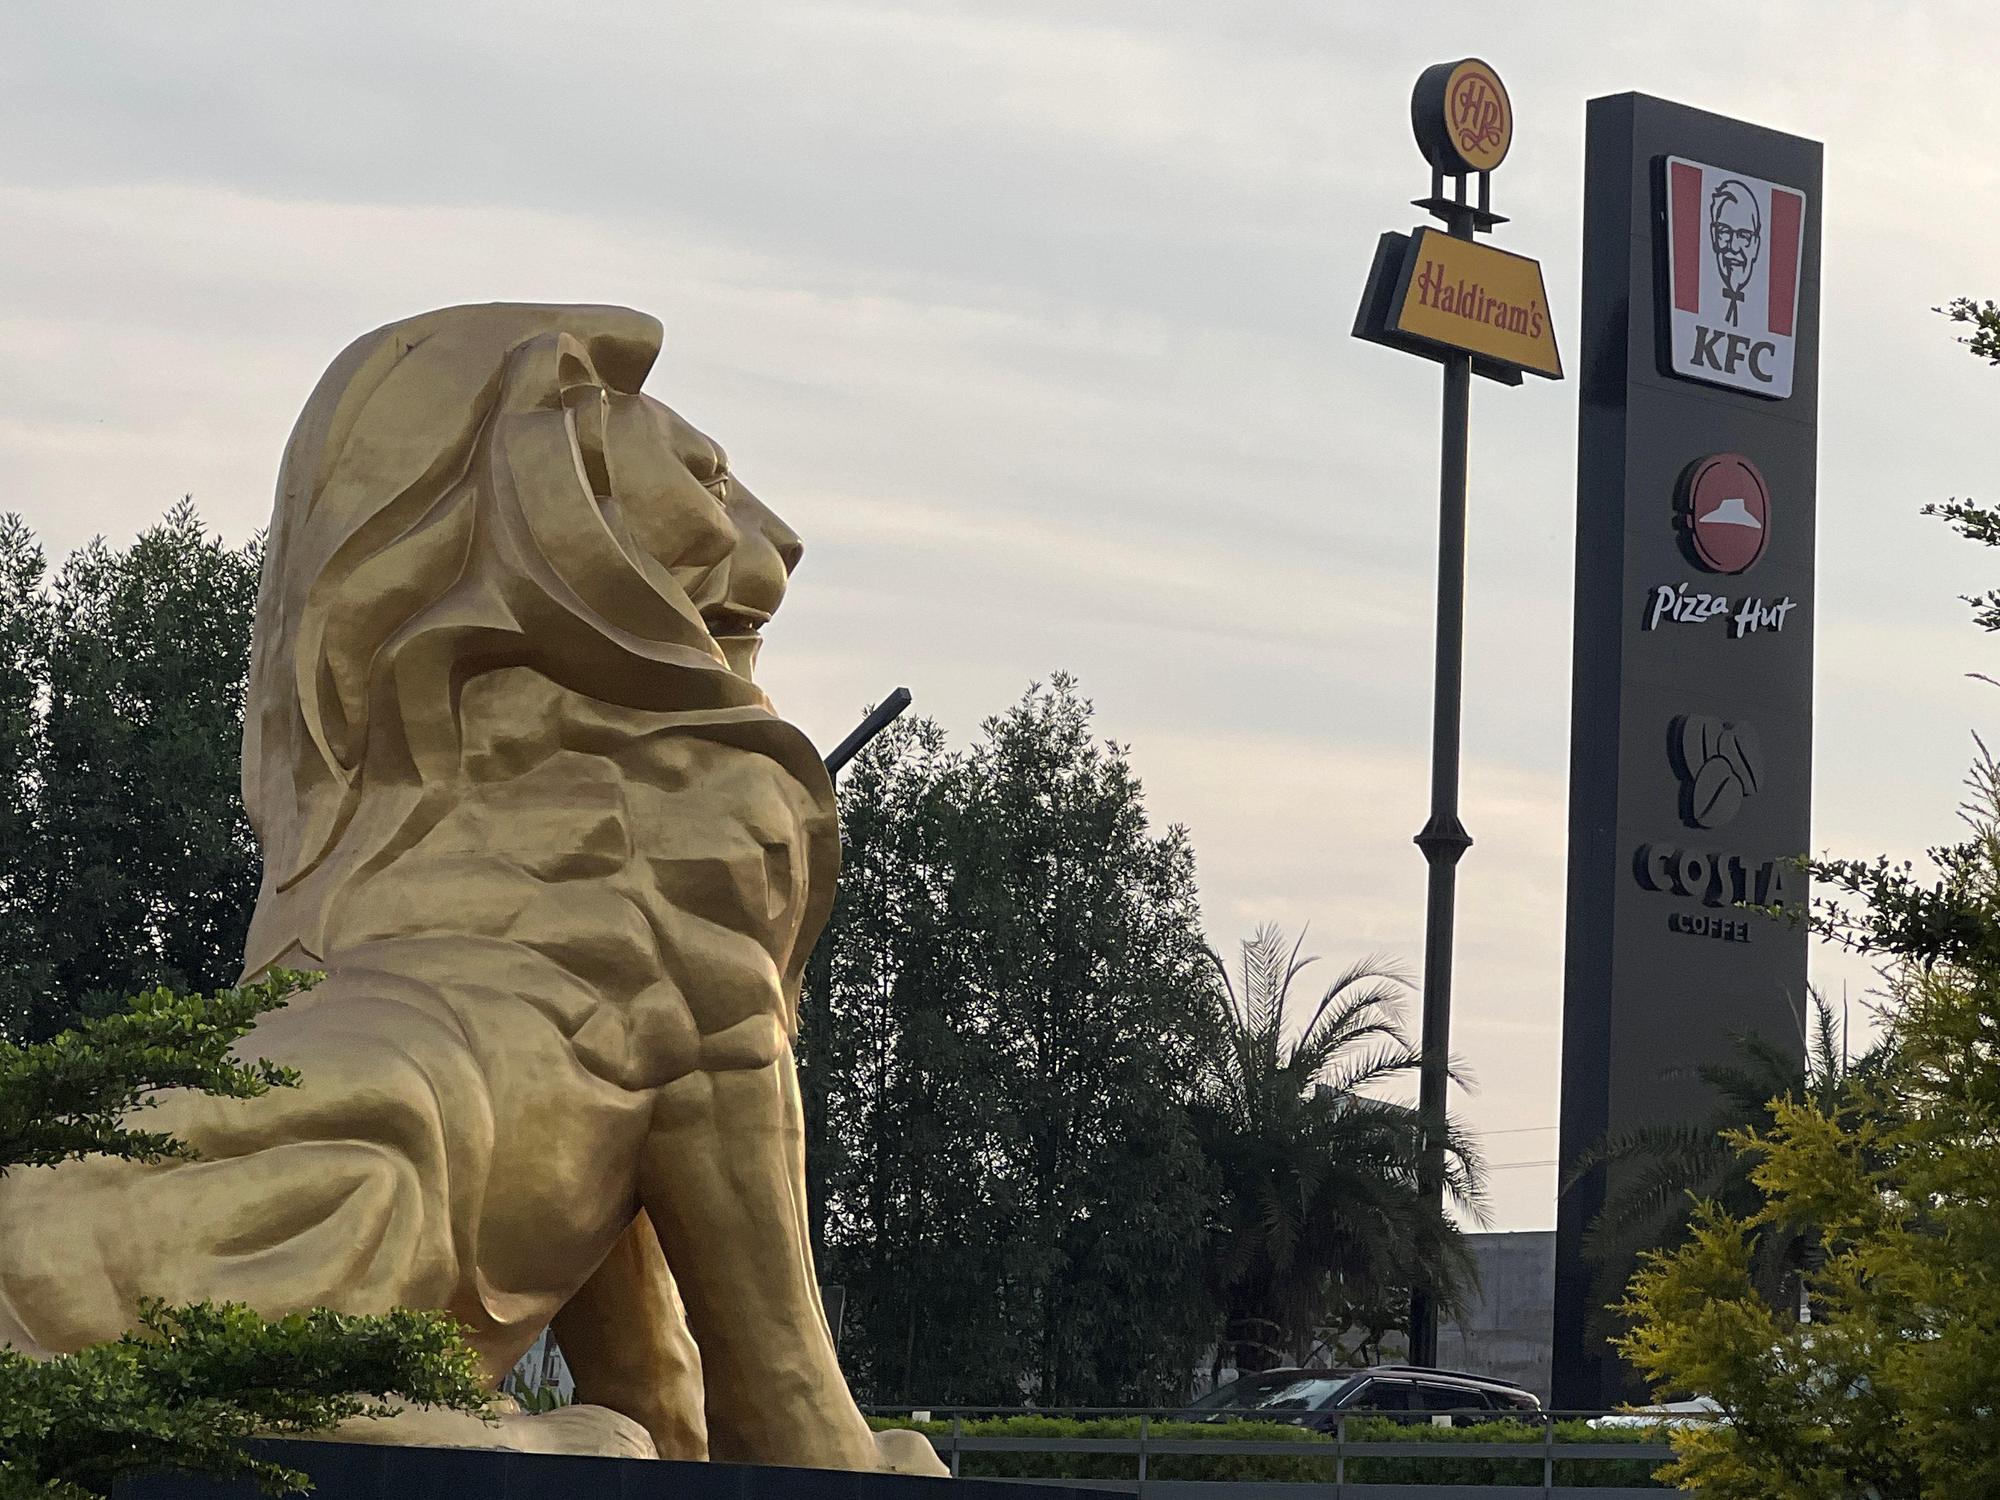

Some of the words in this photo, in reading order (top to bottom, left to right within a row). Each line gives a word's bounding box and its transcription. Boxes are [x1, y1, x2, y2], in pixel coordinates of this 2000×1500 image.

[1418, 261, 1543, 338] Haldiram's
[1690, 325, 1775, 382] KFC
[1651, 582, 1729, 631] Pizza
[1735, 596, 1797, 639] Hut
[1647, 844, 1793, 908] COSTA
